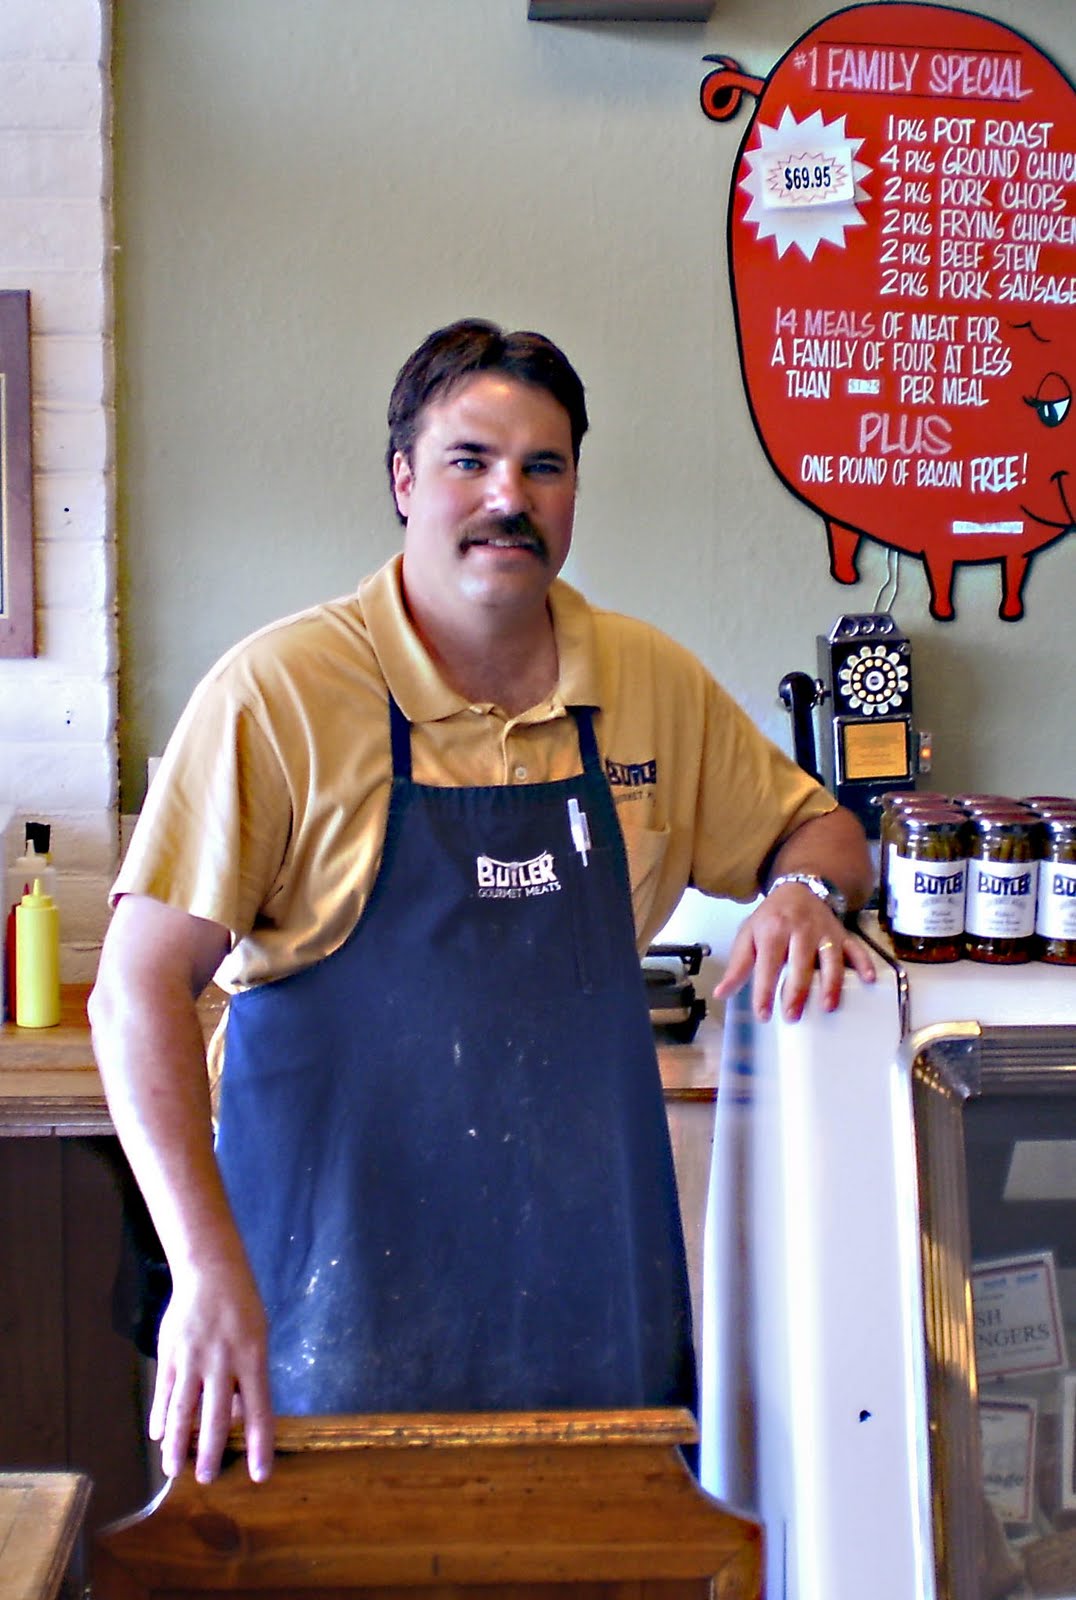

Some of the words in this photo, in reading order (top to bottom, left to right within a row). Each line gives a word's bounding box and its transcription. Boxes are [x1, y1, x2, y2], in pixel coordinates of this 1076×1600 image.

[793, 48, 818, 87] #1
[827, 48, 920, 92] FAMILY
[929, 54, 1033, 98] SPECIAL
[934, 116, 976, 145] POT
[985, 120, 1054, 148] ROAST
[784, 166, 831, 190] $69.95
[879, 146, 900, 172] 4
[904, 151, 935, 174] PKG
[941, 149, 1020, 179] GROUND
[1026, 151, 1076, 182] CHUC
[879, 177, 902, 201] 2
[904, 181, 933, 205] PKG
[940, 179, 993, 207] PORK
[1001, 182, 1067, 212] CHOPS
[879, 209, 902, 234] 2
[902, 213, 933, 237] PKG
[940, 211, 1004, 241] FRYING
[879, 239, 900, 264] 2
[902, 243, 932, 267] PKG
[940, 244, 985, 269] BEEF
[992, 244, 1041, 272] STEW
[879, 270, 900, 295] 2
[900, 274, 929, 298] PKG
[938, 273, 993, 300] PORK
[998, 273, 1076, 304] SAUSAGE
[774, 306, 797, 335] 14
[804, 309, 876, 339] MEALS
[881, 311, 905, 339] OF
[911, 314, 959, 342] MEAT
[967, 316, 1003, 345] FOR
[771, 338, 786, 367] A
[793, 338, 858, 369] FAMILY
[863, 341, 885, 371] OF
[892, 344, 937, 374] FOUR
[943, 344, 965, 374] AT
[972, 346, 1013, 376] LESS
[786, 370, 831, 399] THAN
[900, 375, 935, 405] PER
[942, 377, 989, 407] MEAL
[859, 412, 952, 455] PLUS
[801, 455, 834, 483] ONE
[839, 455, 887, 485] POUND
[893, 458, 911, 487] OF
[917, 459, 963, 488] BACON
[971, 452, 1028, 494] FREE!
[477, 850, 558, 887] BUTLER
[478, 888, 522, 899] GOURMET
[525, 881, 562, 897] MEATS
